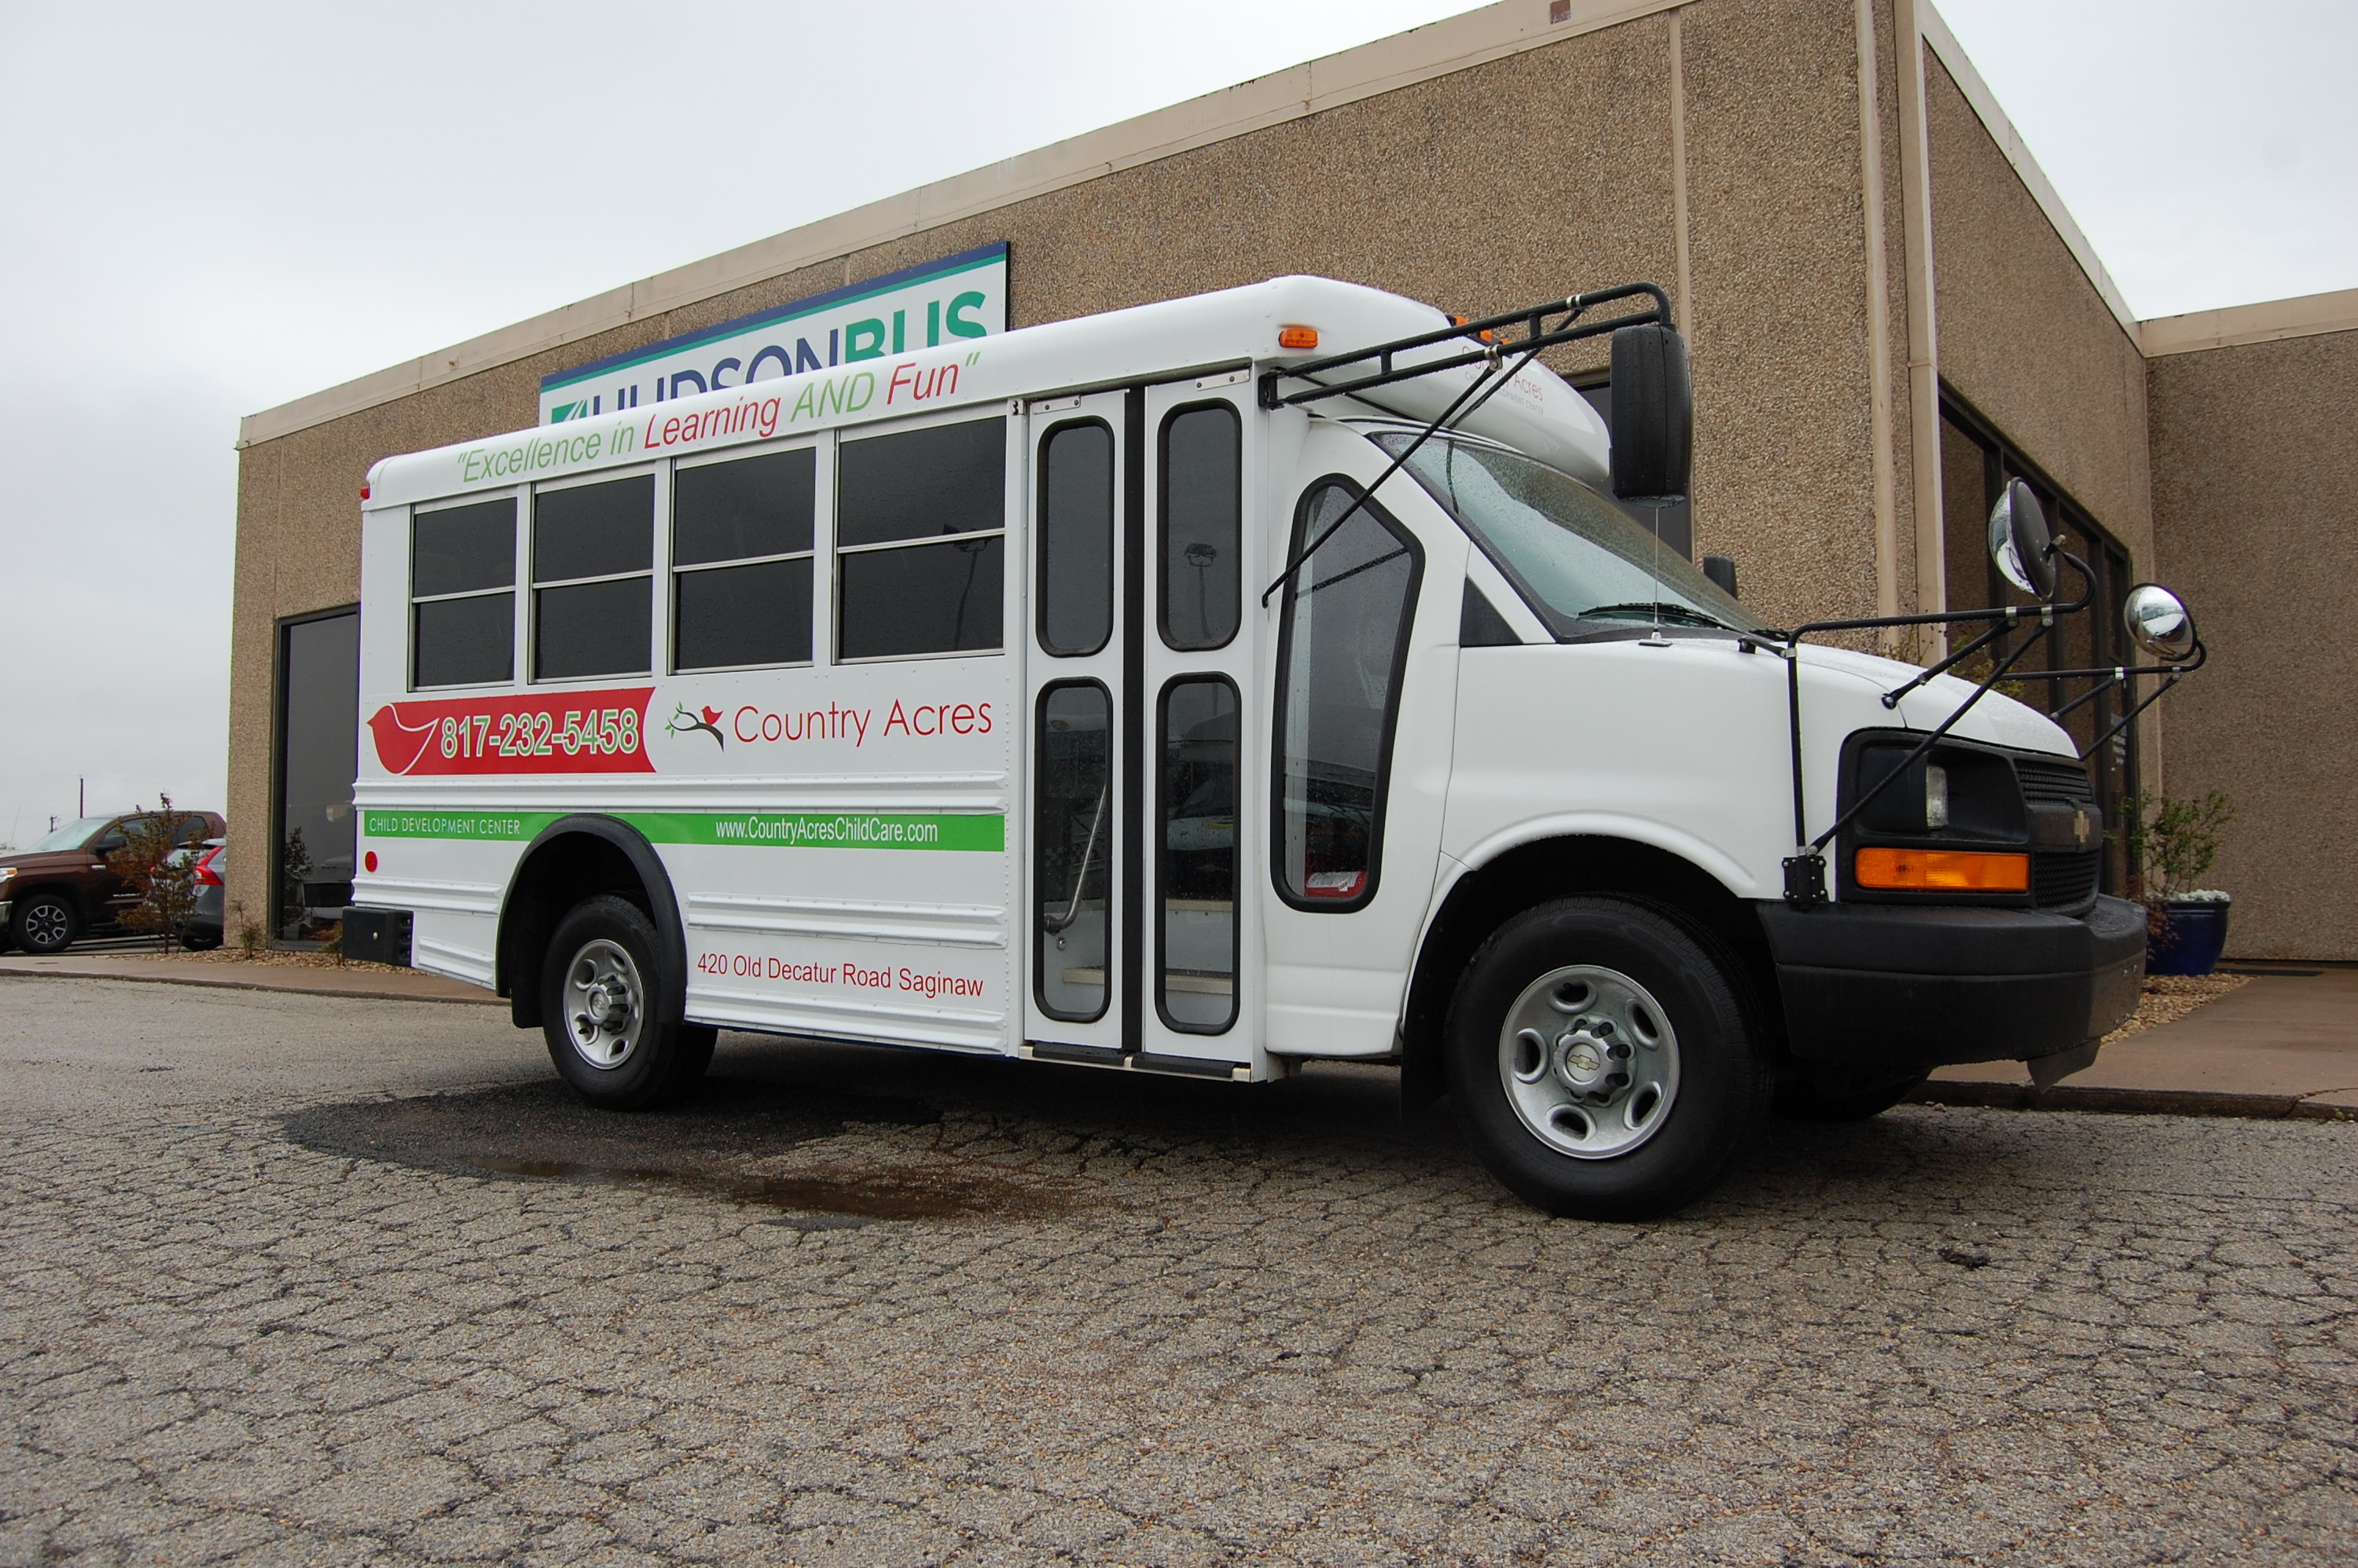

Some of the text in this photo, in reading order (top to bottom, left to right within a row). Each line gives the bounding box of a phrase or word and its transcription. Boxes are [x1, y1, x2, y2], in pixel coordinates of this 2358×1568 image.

[1514, 372, 1544, 402] Acres
[610, 420, 635, 456] in
[644, 395, 781, 450] Learning
[789, 371, 876, 423] AND
[440, 707, 640, 759] 817-232-5458
[734, 699, 993, 747] Country Acres
[369, 817, 521, 835] CHILD DEVELOPMENT CENTER
[715, 815, 938, 846] www.CountryAcresChildCare.com
[696, 953, 984, 999] 420 Old Decatur Road Saginaw
